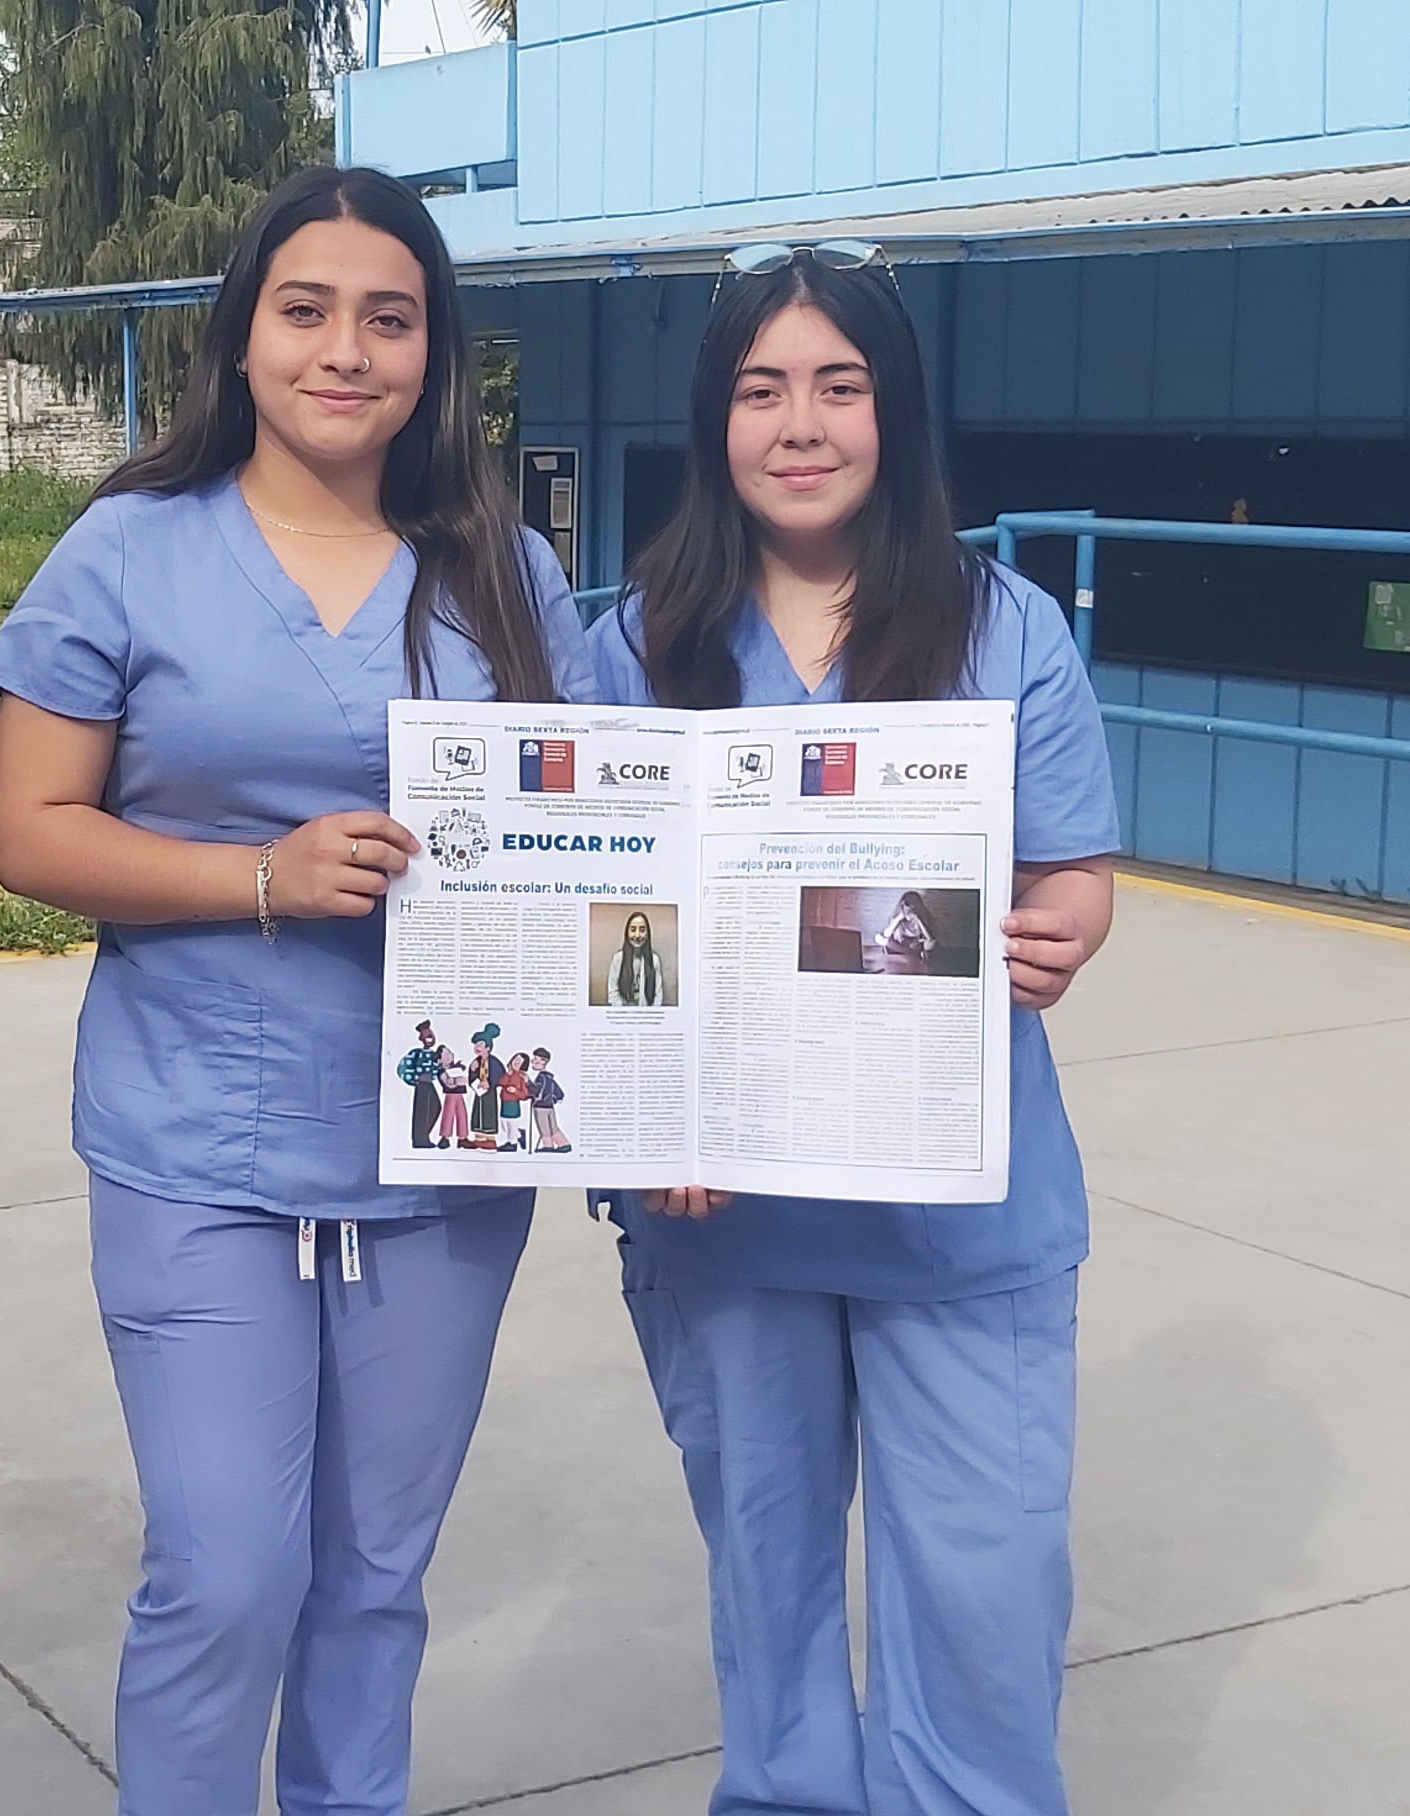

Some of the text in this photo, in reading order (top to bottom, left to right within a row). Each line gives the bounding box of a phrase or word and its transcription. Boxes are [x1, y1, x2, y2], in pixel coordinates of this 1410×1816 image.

[619, 763, 670, 780] CORE
[905, 763, 968, 780] CORE
[502, 833, 656, 853] EDUCAR HOY
[826, 843, 845, 854] del
[849, 842, 905, 857] Bullying:
[718, 859, 959, 872] consejos para prevenir el Acoso Escolar
[441, 880, 497, 892] Inclusión
[501, 882, 551, 893] escolar:
[555, 882, 571, 893] Un
[621, 884, 653, 895] social
